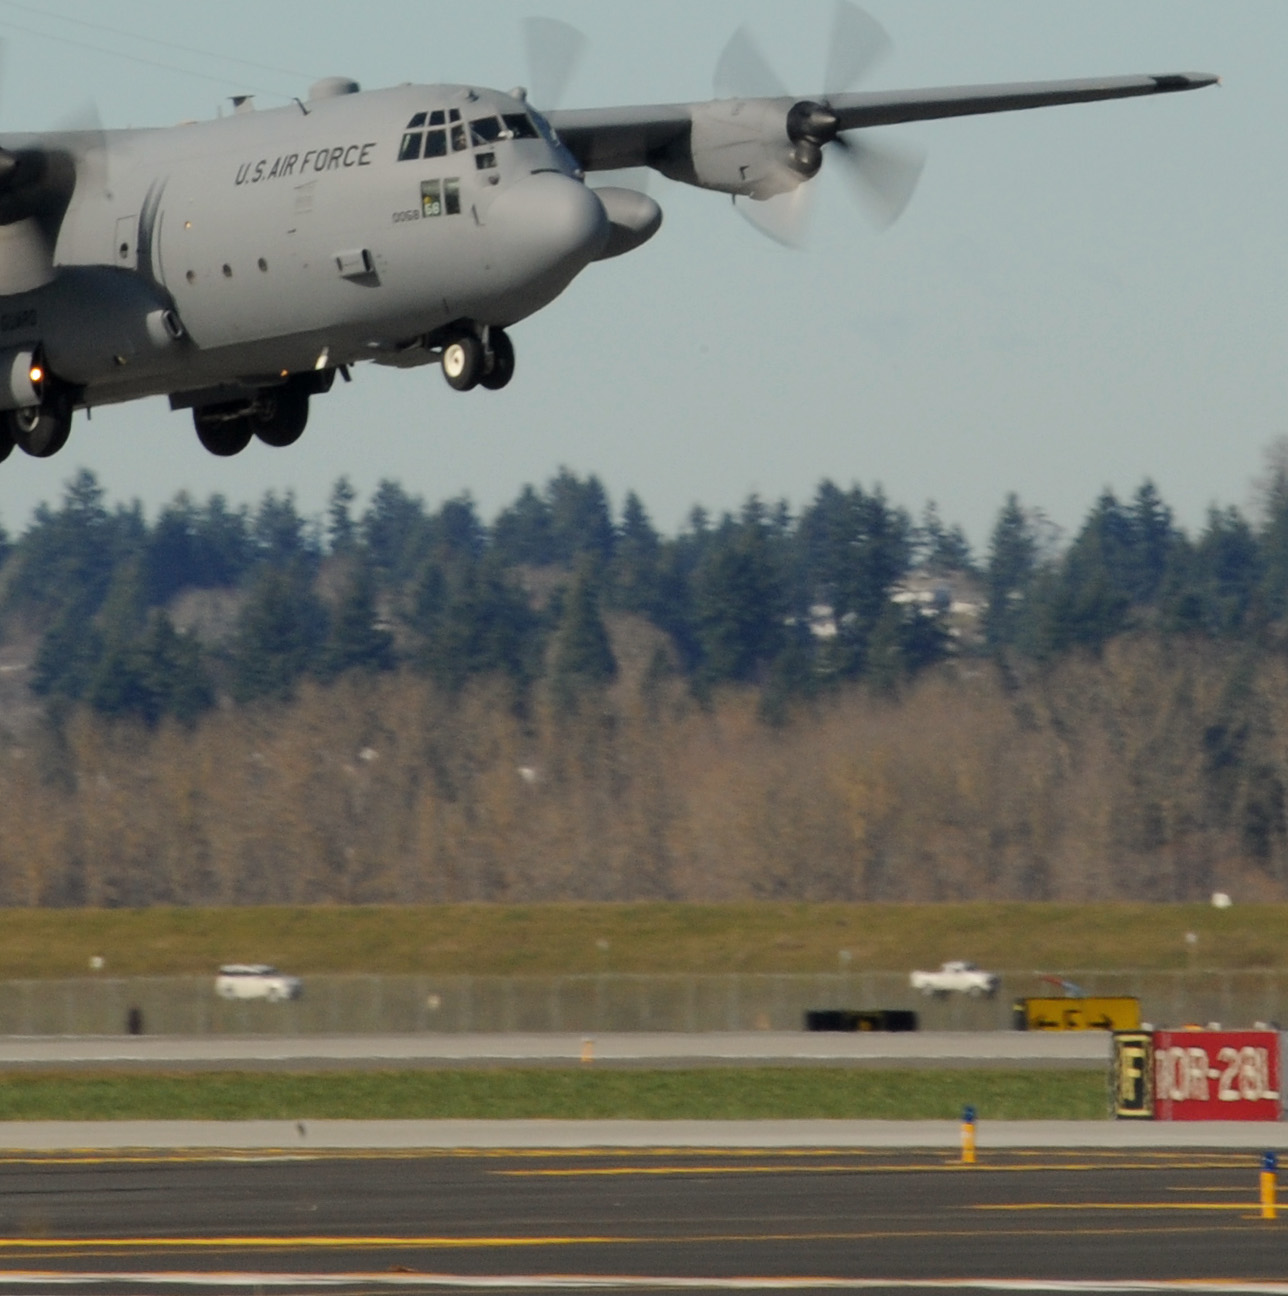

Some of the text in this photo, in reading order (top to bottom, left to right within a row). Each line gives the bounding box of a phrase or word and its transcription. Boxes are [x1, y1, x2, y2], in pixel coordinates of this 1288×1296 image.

[235, 142, 377, 186] U.S. AIR FORCE
[1121, 1046, 1146, 1101] F
